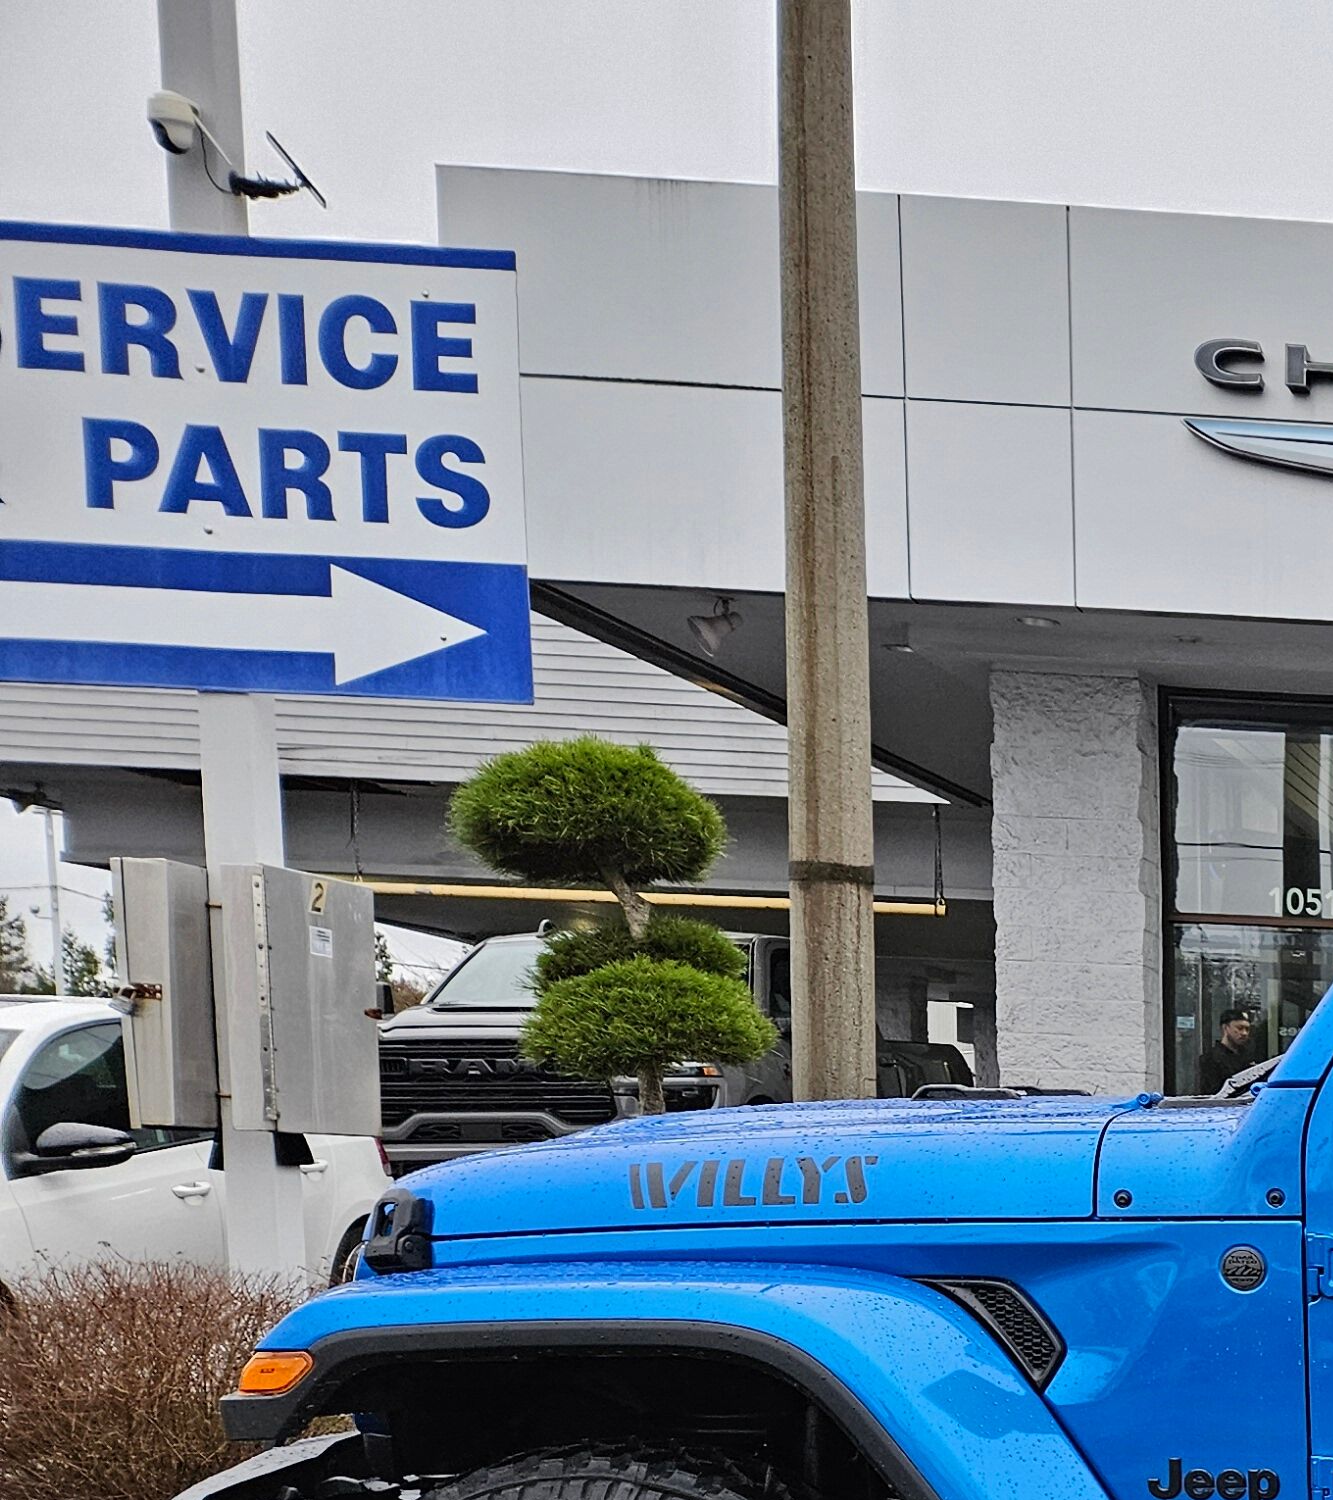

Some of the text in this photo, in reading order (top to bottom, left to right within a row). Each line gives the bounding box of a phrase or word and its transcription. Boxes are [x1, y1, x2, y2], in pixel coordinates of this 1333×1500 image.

[0, 275, 480, 395] ERVICE
[81, 416, 491, 530] PARTS
[311, 882, 325, 912] 2
[628, 1155, 879, 1210] WILLYS
